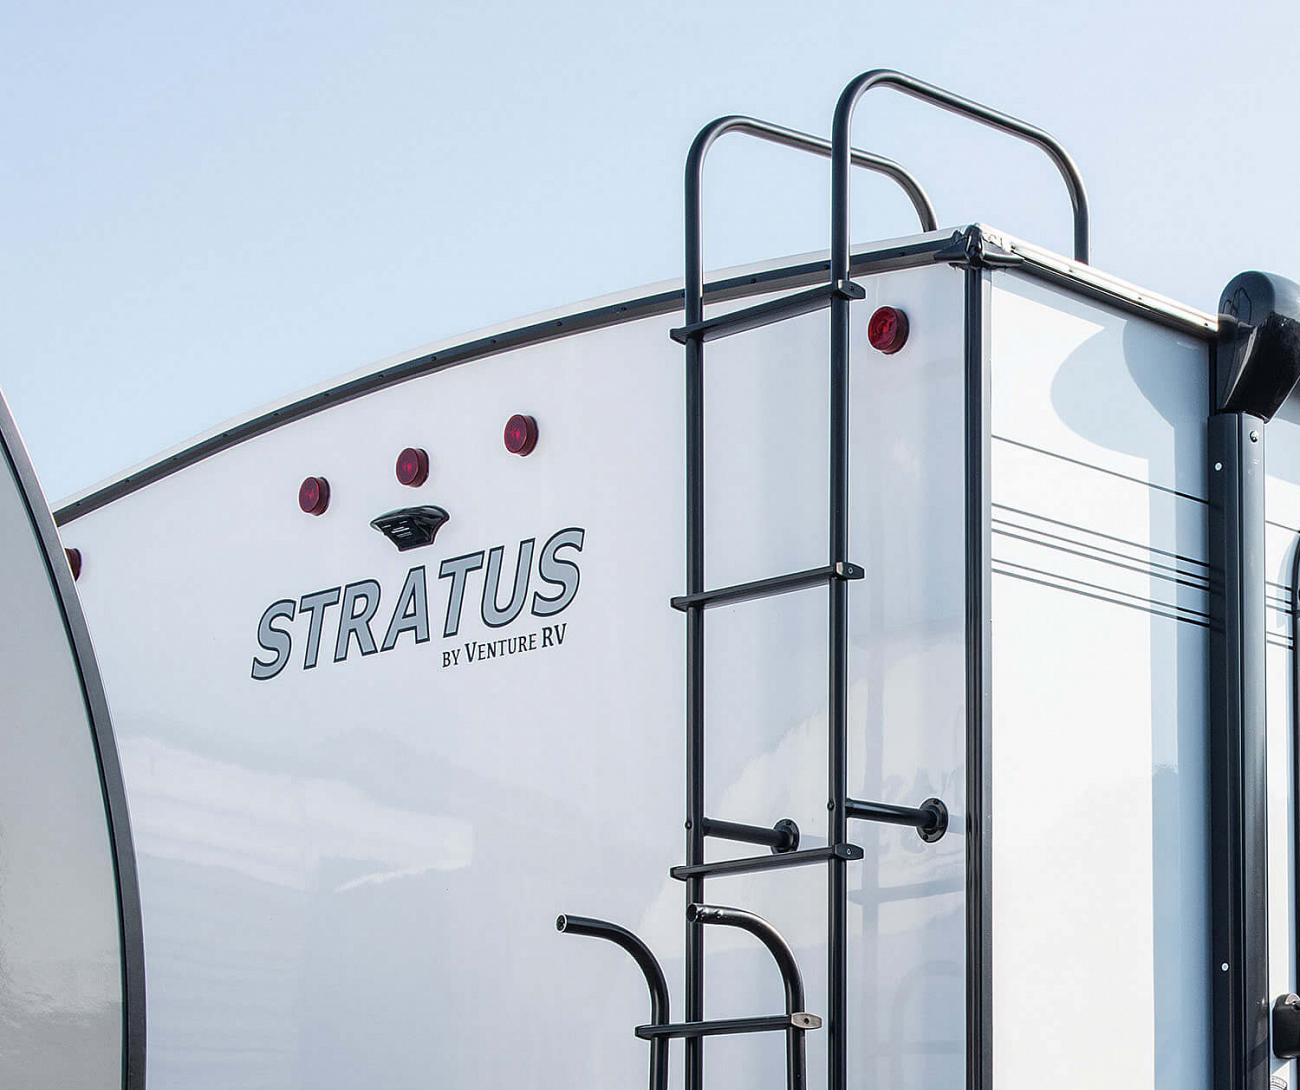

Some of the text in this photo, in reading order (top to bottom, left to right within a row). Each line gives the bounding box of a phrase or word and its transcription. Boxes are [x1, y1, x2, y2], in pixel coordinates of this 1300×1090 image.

[251, 527, 585, 680] STRATUS
[442, 623, 567, 668] BY VENTURE RV
